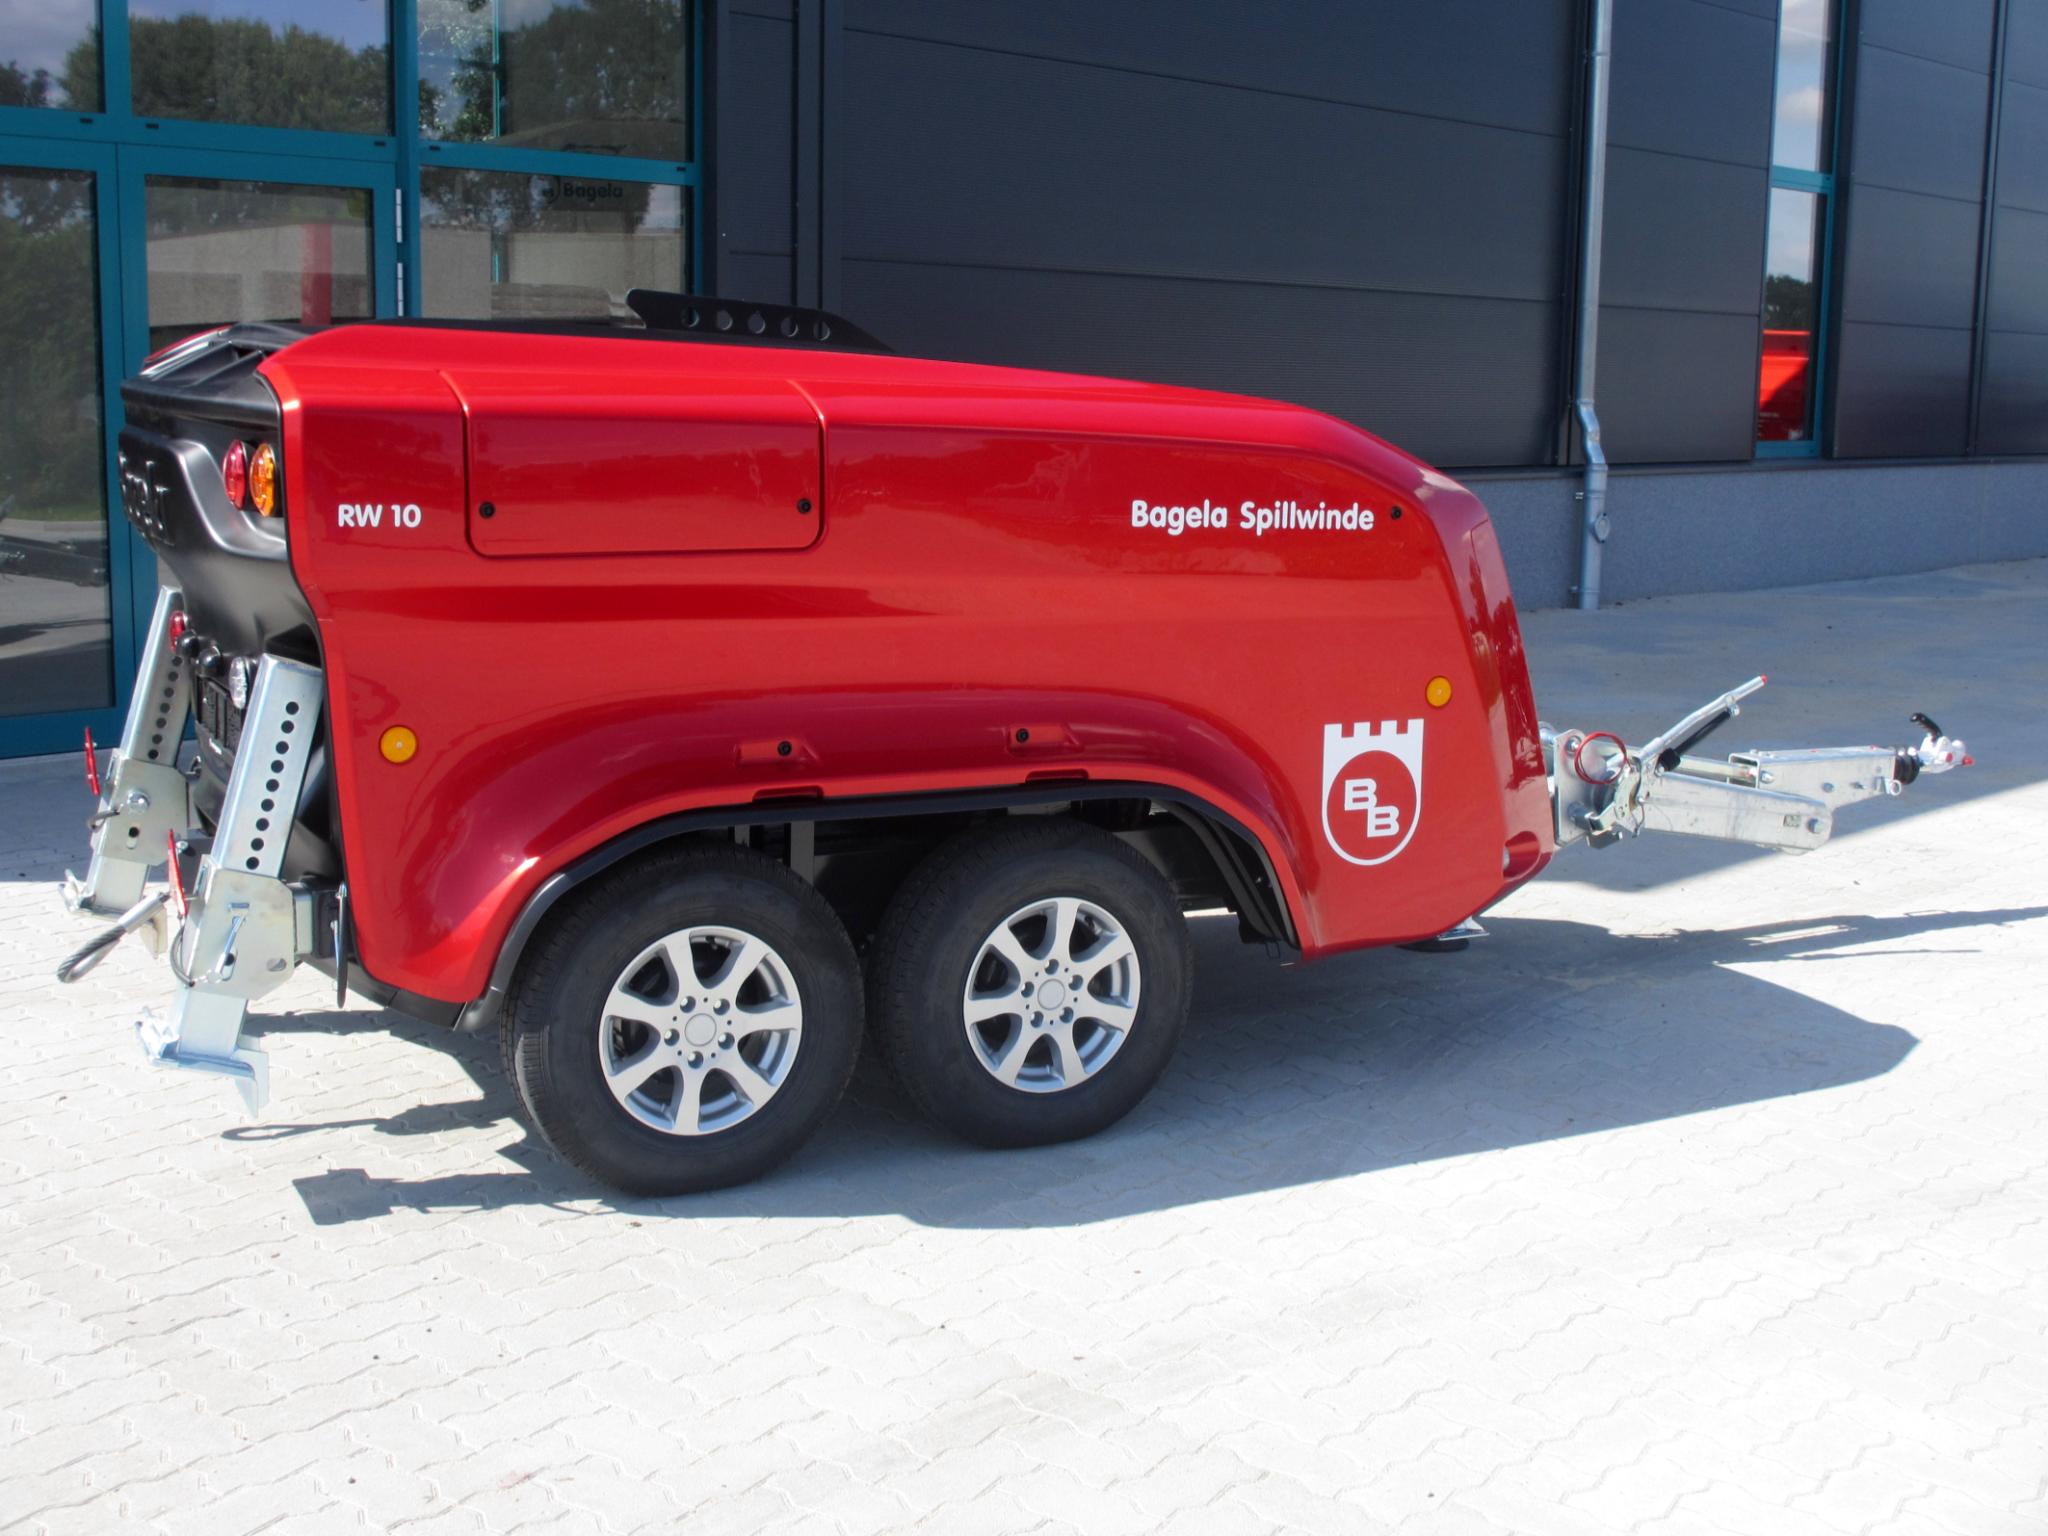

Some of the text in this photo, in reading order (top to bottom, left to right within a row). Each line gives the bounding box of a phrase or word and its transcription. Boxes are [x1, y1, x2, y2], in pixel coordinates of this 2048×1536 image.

[563, 183, 624, 201] Bagela
[338, 504, 422, 528] RW 10
[1131, 499, 1375, 536] Bagela Spillwinde
